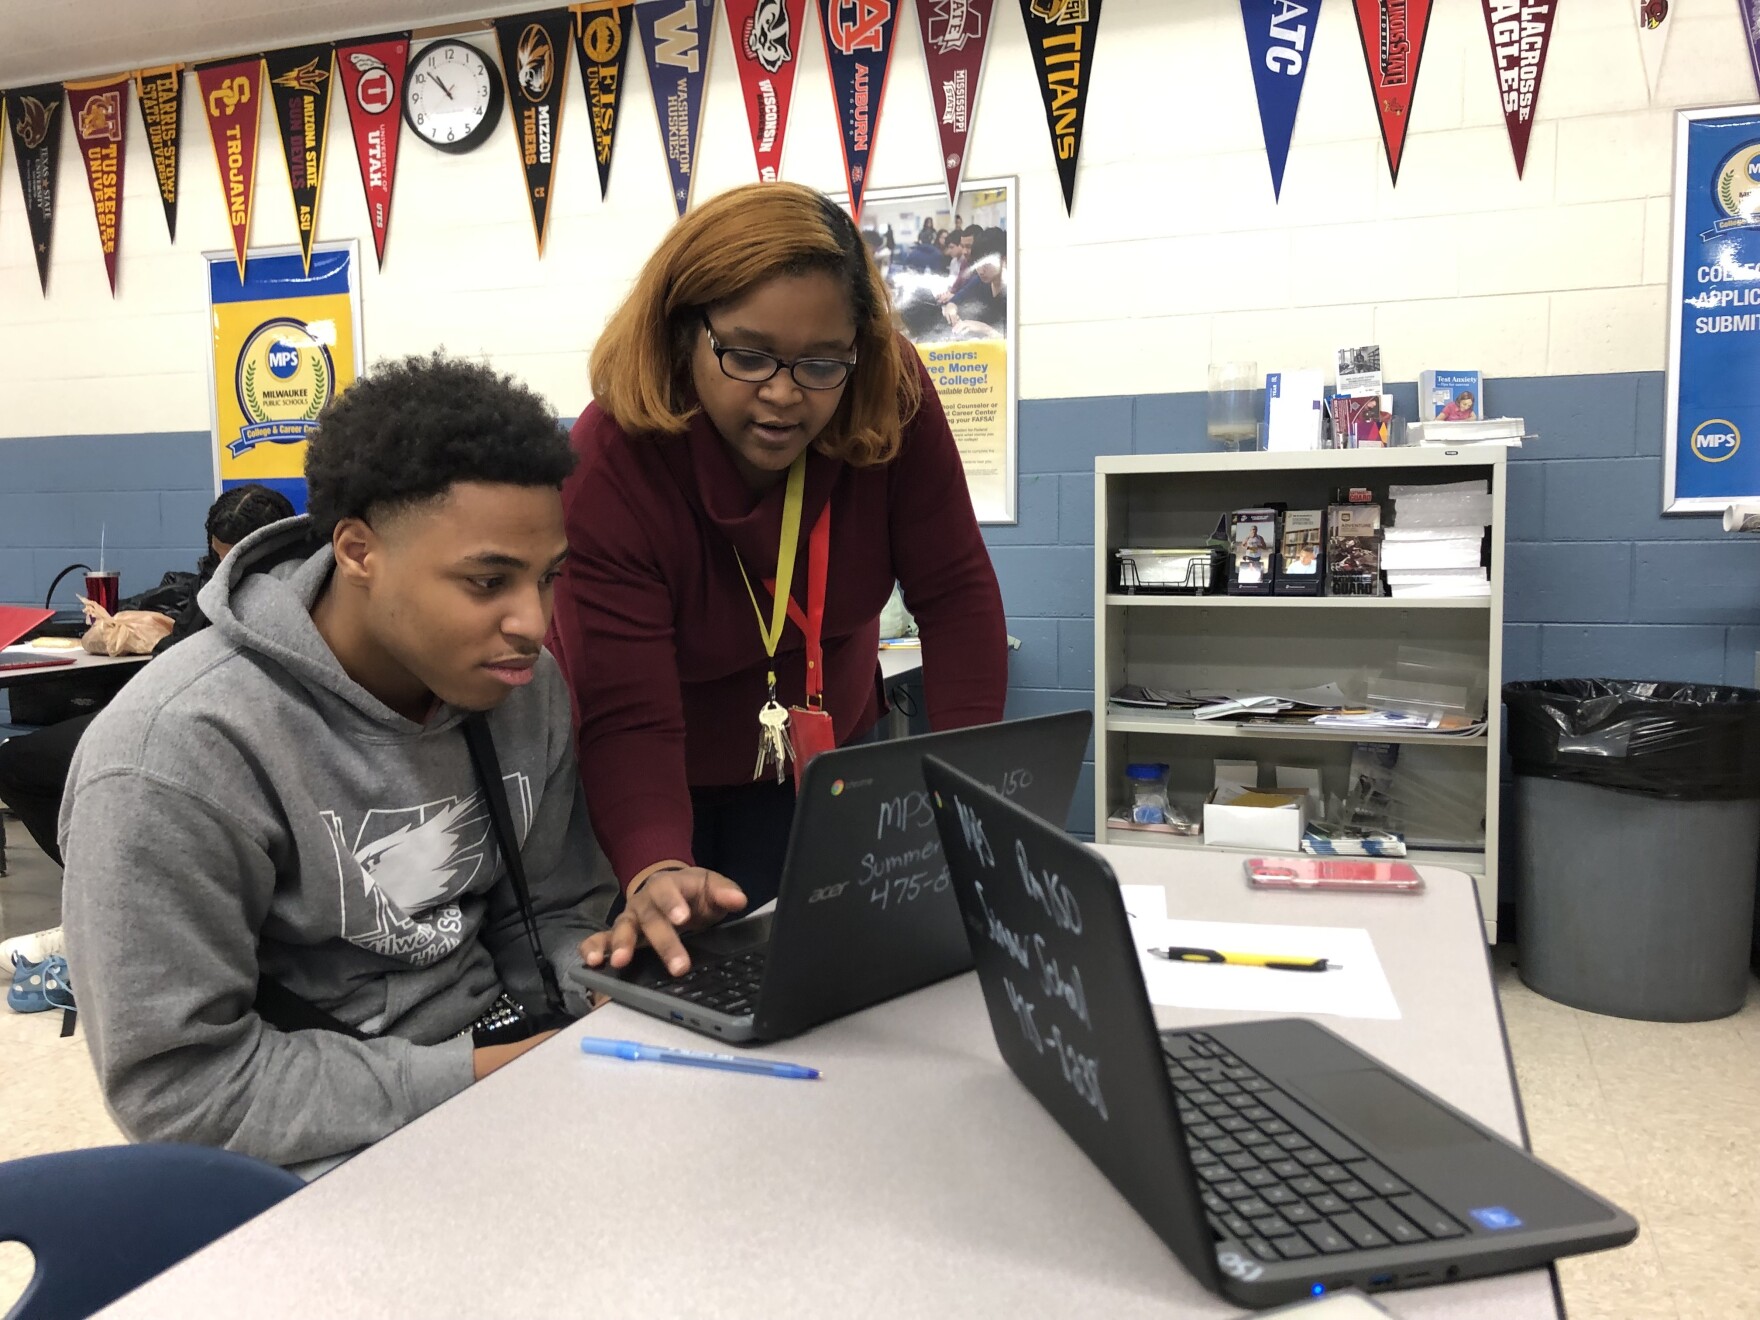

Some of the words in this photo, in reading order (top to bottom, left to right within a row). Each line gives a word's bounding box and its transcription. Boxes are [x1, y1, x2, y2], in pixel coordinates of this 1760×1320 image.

[654, 0, 699, 74] W
[428, 56, 436, 67] 11
[445, 48, 455, 60] 12
[465, 53, 469, 63] 1
[415, 73, 425, 84] 10
[477, 65, 484, 76] 2
[143, 84, 160, 123] STATE
[412, 92, 419, 104] 9
[482, 85, 488, 97] 3
[944, 86, 955, 119] STATE
[955, 70, 966, 132] MISSISSIPPI
[1042, 25, 1083, 160] TITANS
[288, 97, 303, 131] SUN
[417, 113, 424, 125] 8
[475, 105, 483, 116] 4
[599, 63, 619, 165] FISK
[758, 79, 777, 153] WISCONSIN
[854, 62, 869, 151] AUBURN
[303, 95, 316, 149] ARIZONA
[432, 128, 437, 138] 7
[447, 130, 455, 142] 6
[464, 123, 471, 134] 5
[523, 107, 537, 165] TIGERS
[538, 105, 551, 164] MIZZOU
[668, 96, 680, 160] HUSKIES
[677, 78, 690, 175] WASHINGTON
[156, 79, 178, 203] HARRIS-STOWE
[380, 123, 388, 178] UNIVERSITY
[39, 146, 50, 179] TEXAS
[149, 126, 170, 201] UNIVERSITY
[289, 135, 306, 190] DEVILS
[306, 151, 318, 188] STATE
[367, 130, 383, 188] UTAH
[226, 124, 246, 226] TROJANS
[43, 189, 52, 219] STATE
[88, 147, 111, 254] UNIVERSITY
[101, 143, 118, 253] TUSKEGEE
[300, 205, 311, 231] ASU
[375, 202, 383, 228] UTES
[269, 350, 299, 368] MPS
[926, 365, 945, 373] ree
[948, 363, 989, 375] Money
[928, 351, 978, 362] Seniors:
[262, 388, 308, 399] MILWAUKEE
[937, 387, 963, 395] vailable
[963, 386, 989, 395] October
[939, 374, 989, 387] College!
[1436, 375, 1451, 383] Test
[1452, 376, 1478, 384] Anxiety
[262, 399, 281, 407] PUBLIC
[282, 398, 309, 406] SCHOOLS
[246, 427, 271, 439] College
[272, 425, 278, 434] &
[279, 425, 302, 434] Career
[1696, 433, 1736, 448] MPS
[877, 790, 935, 840] MPS
[1001, 768, 1033, 797] 150
[808, 880, 850, 903] acer
